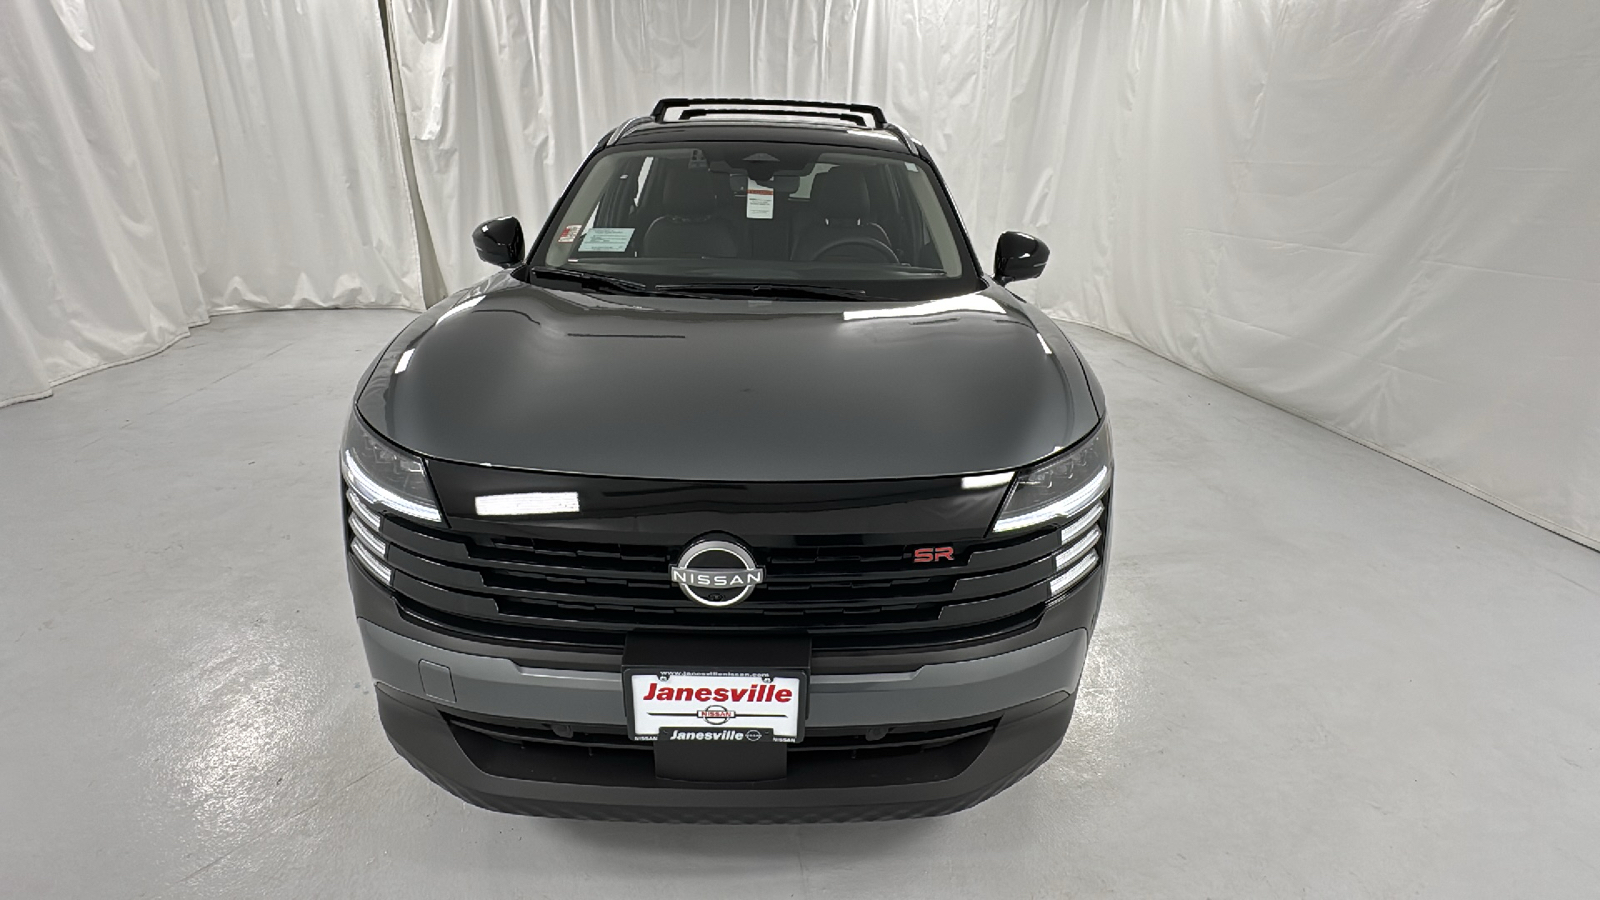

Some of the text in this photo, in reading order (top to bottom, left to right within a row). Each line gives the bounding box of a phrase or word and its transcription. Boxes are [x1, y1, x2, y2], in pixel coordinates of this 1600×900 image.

[914, 547, 954, 562] SR
[673, 570, 761, 586] NISSAN
[643, 683, 792, 703] Janesville
[670, 730, 744, 741] Janesville
